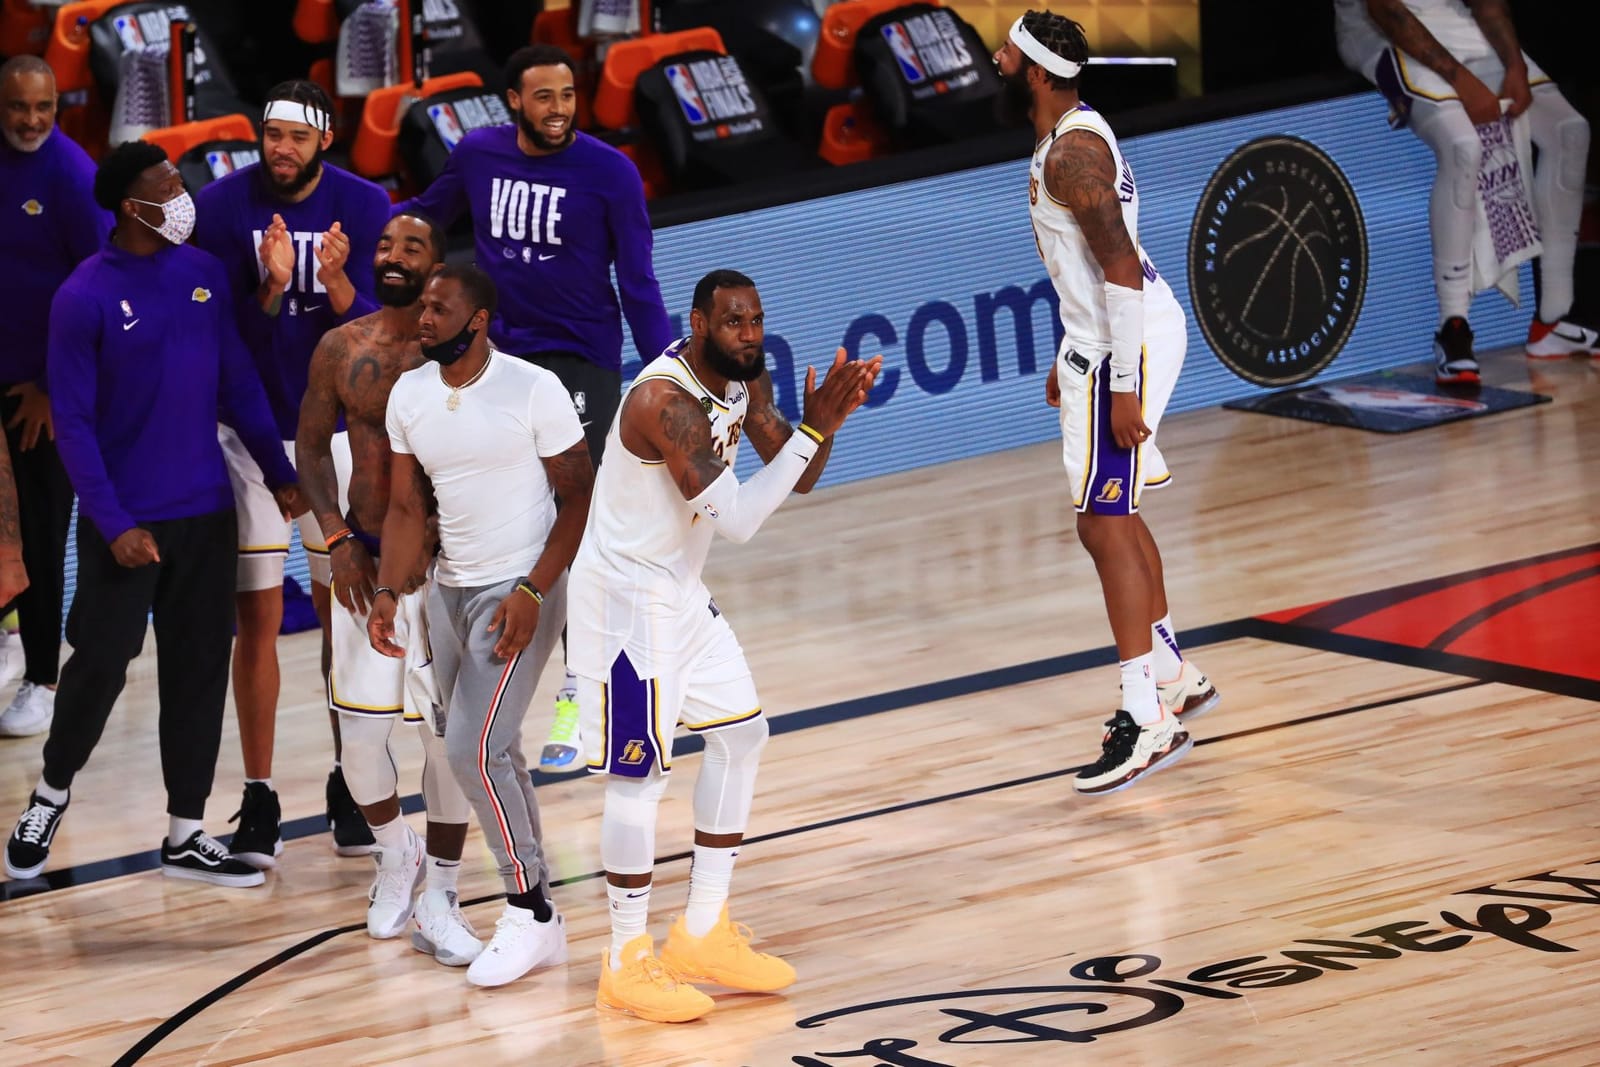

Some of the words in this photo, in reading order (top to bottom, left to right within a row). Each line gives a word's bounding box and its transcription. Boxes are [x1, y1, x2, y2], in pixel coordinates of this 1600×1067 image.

[490, 177, 567, 246] VOTE
[252, 229, 329, 294] VTE
[1266, 256, 1351, 364] ASSOCIATION
